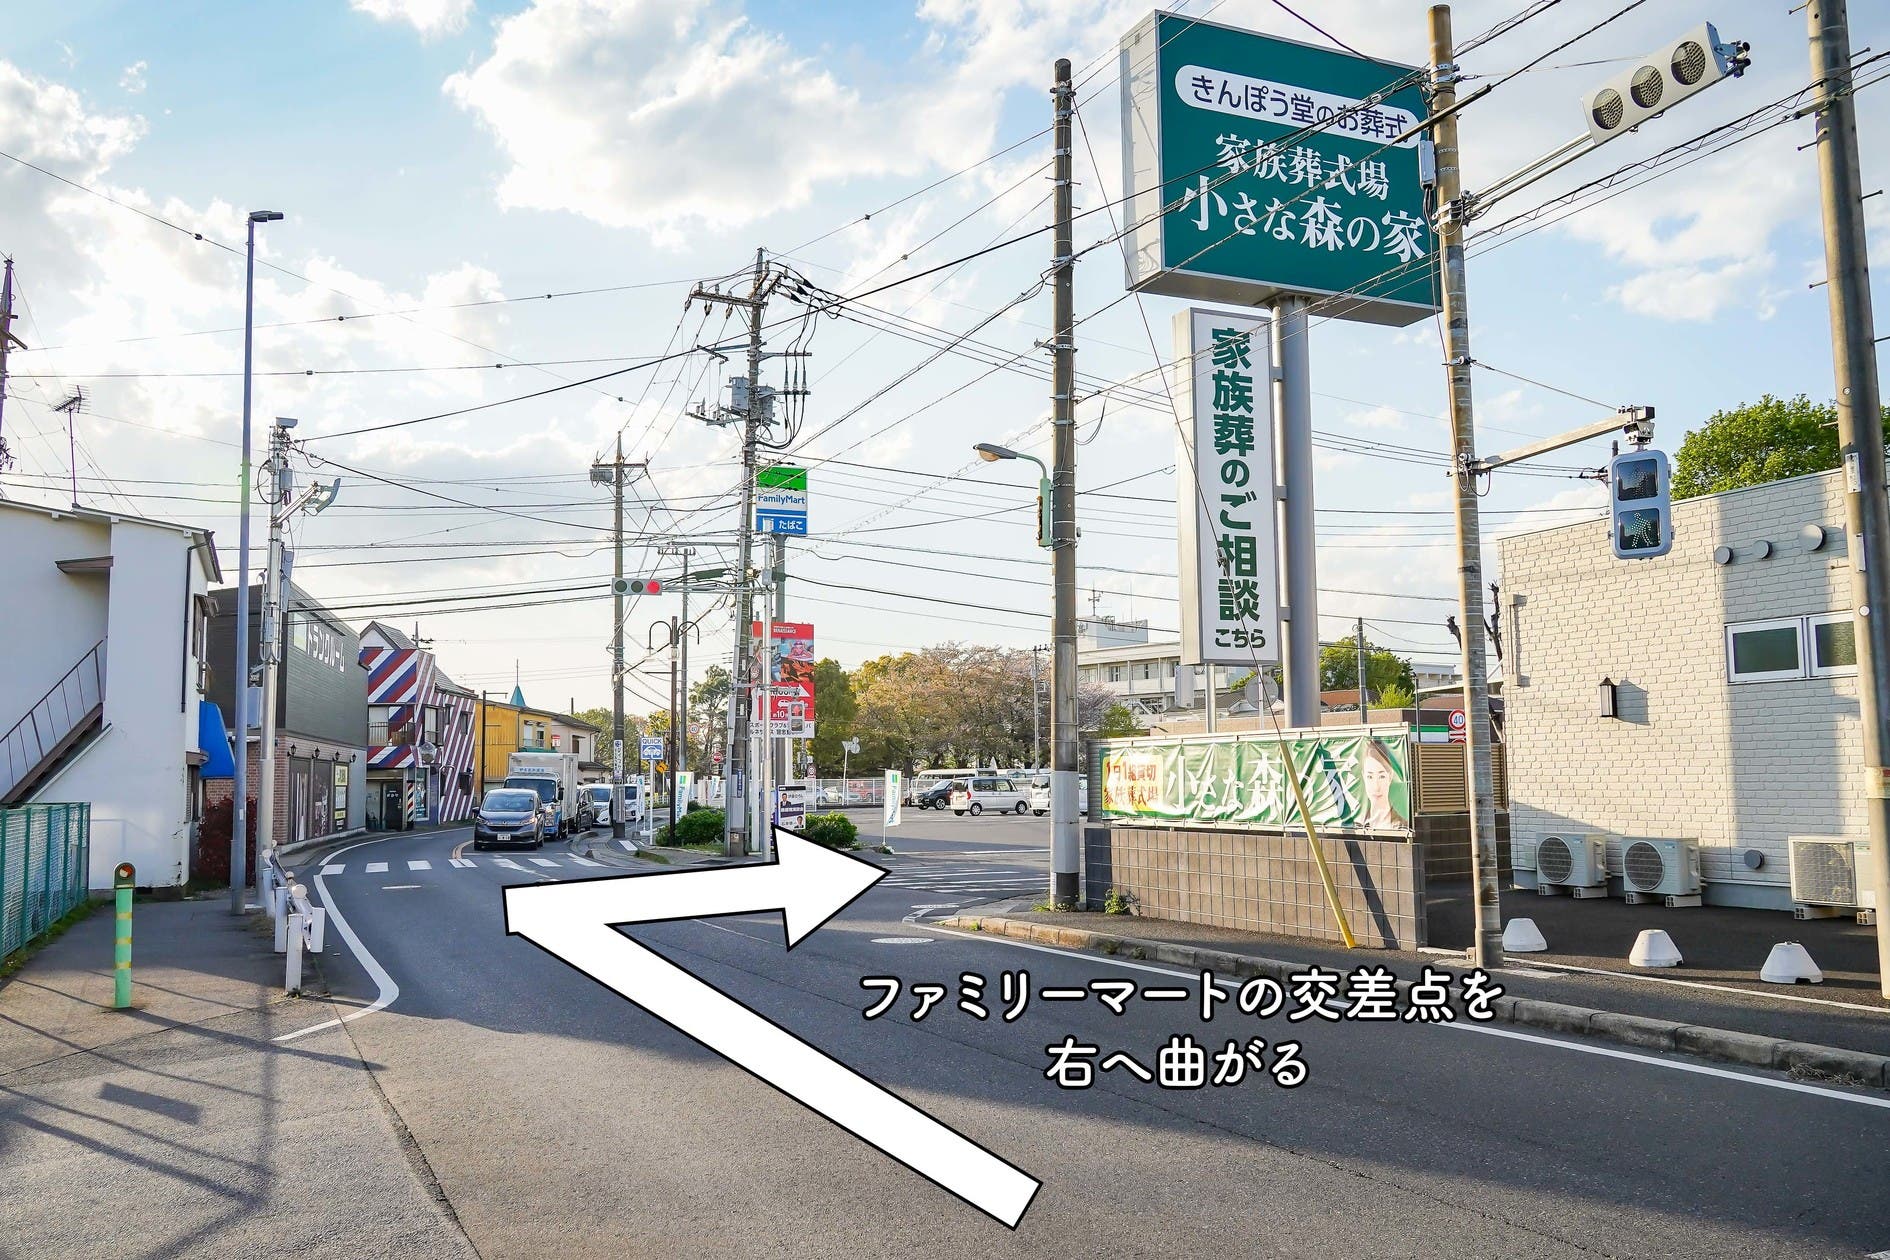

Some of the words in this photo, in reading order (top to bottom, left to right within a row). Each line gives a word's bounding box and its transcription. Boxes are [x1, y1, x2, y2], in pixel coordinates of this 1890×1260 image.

[1191, 75, 1410, 145] きんぽう堂のお葬式
[1215, 133, 1390, 201] 家族葬式場
[1179, 176, 1426, 262] 小さな森の家
[758, 494, 806, 505] FamilyMart
[1211, 327, 1260, 622] 家族葬のご相談
[779, 519, 804, 530] たばこ
[307, 620, 346, 673] トランクルーム
[1214, 627, 1266, 649] こちら
[1453, 715, 1464, 725] 40
[1167, 752, 1361, 824] 小さな森の家
